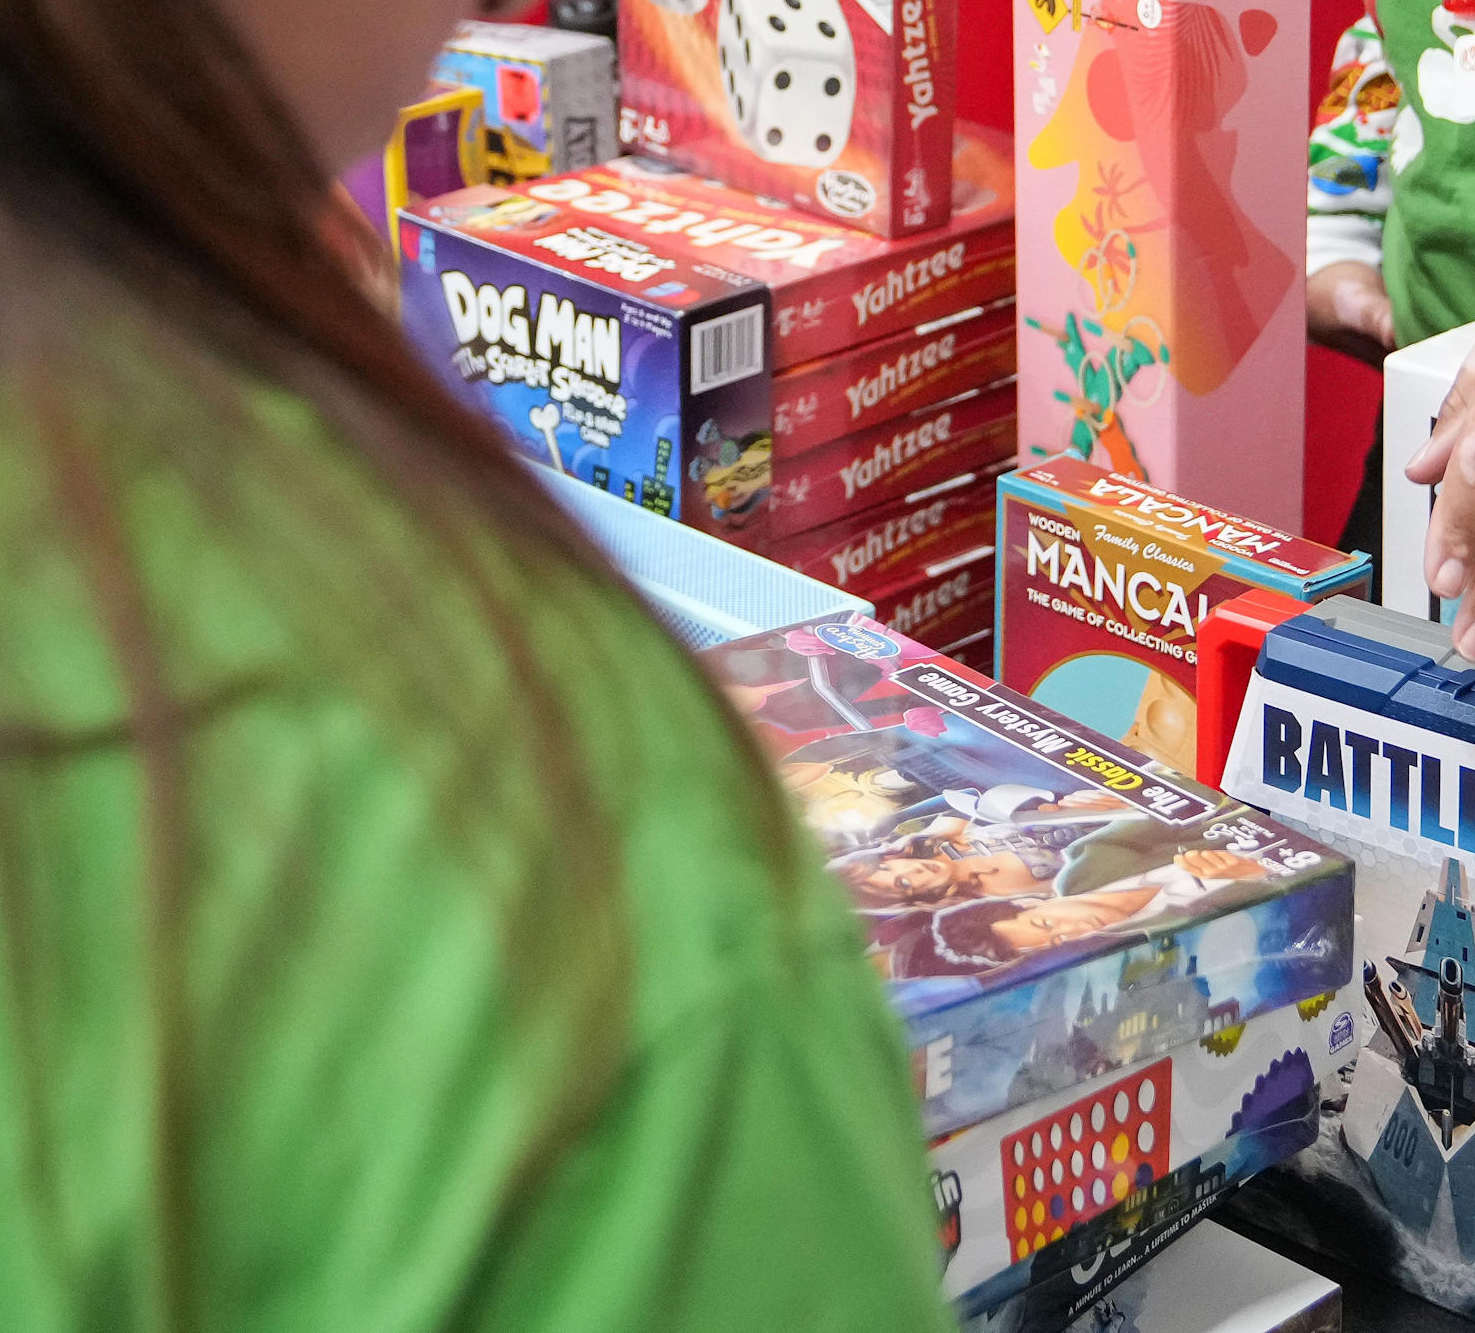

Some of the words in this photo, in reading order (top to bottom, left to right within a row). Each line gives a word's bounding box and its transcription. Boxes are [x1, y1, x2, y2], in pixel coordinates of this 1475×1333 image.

[527, 179, 845, 268] Yahtzee
[852, 243, 965, 325] Yahtzee
[440, 270, 531, 356] DOG
[535, 291, 620, 384] MAN
[846, 333, 956, 418] Yahtzee
[840, 412, 951, 500] Yahtzee
[831, 500, 947, 585] Yahtzee
[1028, 513, 1081, 542] WOODEN
[1089, 478, 1281, 554] MANCALA
[1093, 524, 1139, 555] Family
[1142, 542, 1195, 573] Classics
[1208, 538, 1254, 557] WOODEN
[826, 625, 879, 659] Hasbro
[1027, 587, 1050, 608] THE
[1051, 597, 1085, 622] GAME
[1087, 611, 1105, 628] OF
[1105, 620, 1183, 660] COLLECTING
[918, 672, 981, 707] Game
[975, 702, 1074, 754] Mystery
[1065, 747, 1143, 791] Classic
[1142, 785, 1190, 816] The
[1278, 847, 1322, 869] 8+
[1075, 1283, 1103, 1312] MINUTE
[1103, 1273, 1113, 1285] TO
[1151, 1220, 1180, 1250] LIFETIME
